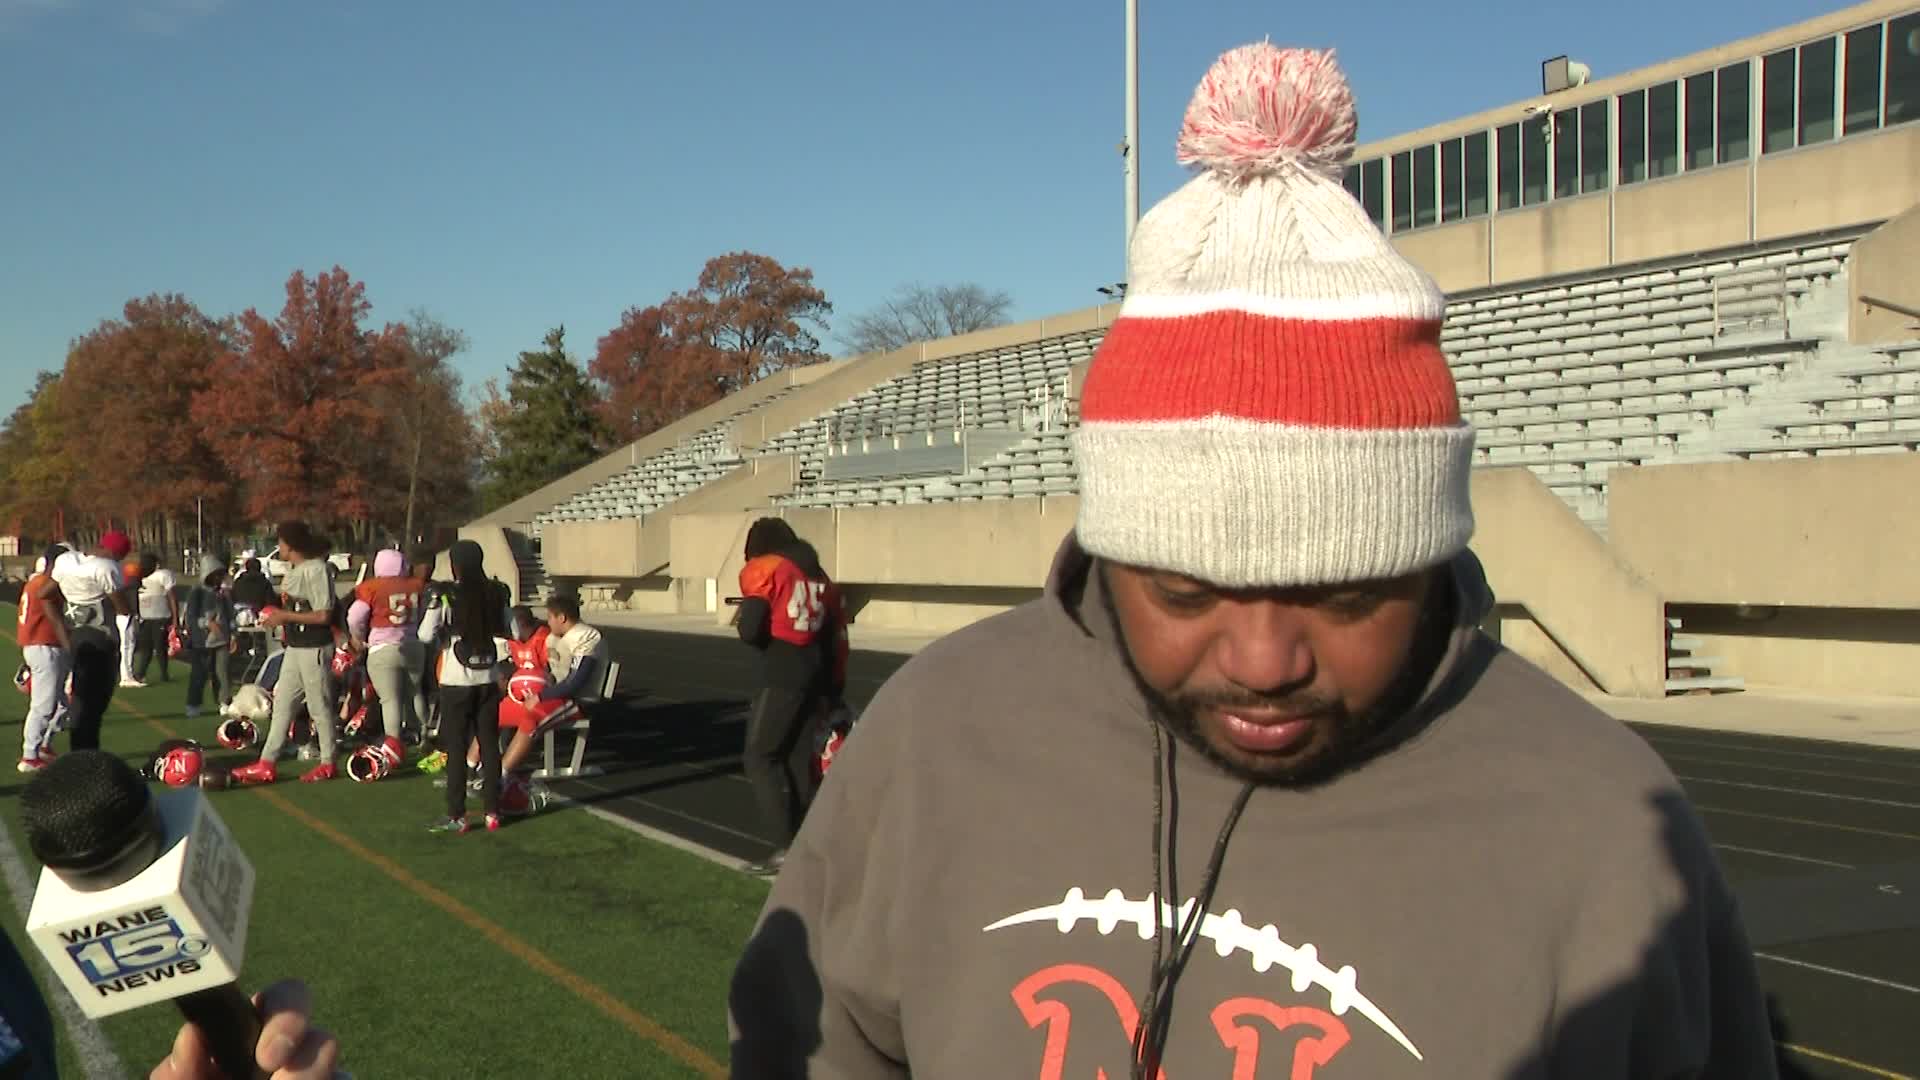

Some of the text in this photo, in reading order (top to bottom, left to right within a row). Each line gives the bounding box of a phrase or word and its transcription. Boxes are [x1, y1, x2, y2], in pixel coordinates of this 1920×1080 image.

[388, 592, 419, 625] 51
[786, 580, 825, 632] 45
[174, 757, 186, 774] N
[59, 905, 169, 945] WANE
[73, 920, 187, 982] 15
[95, 958, 202, 998] NEWS
